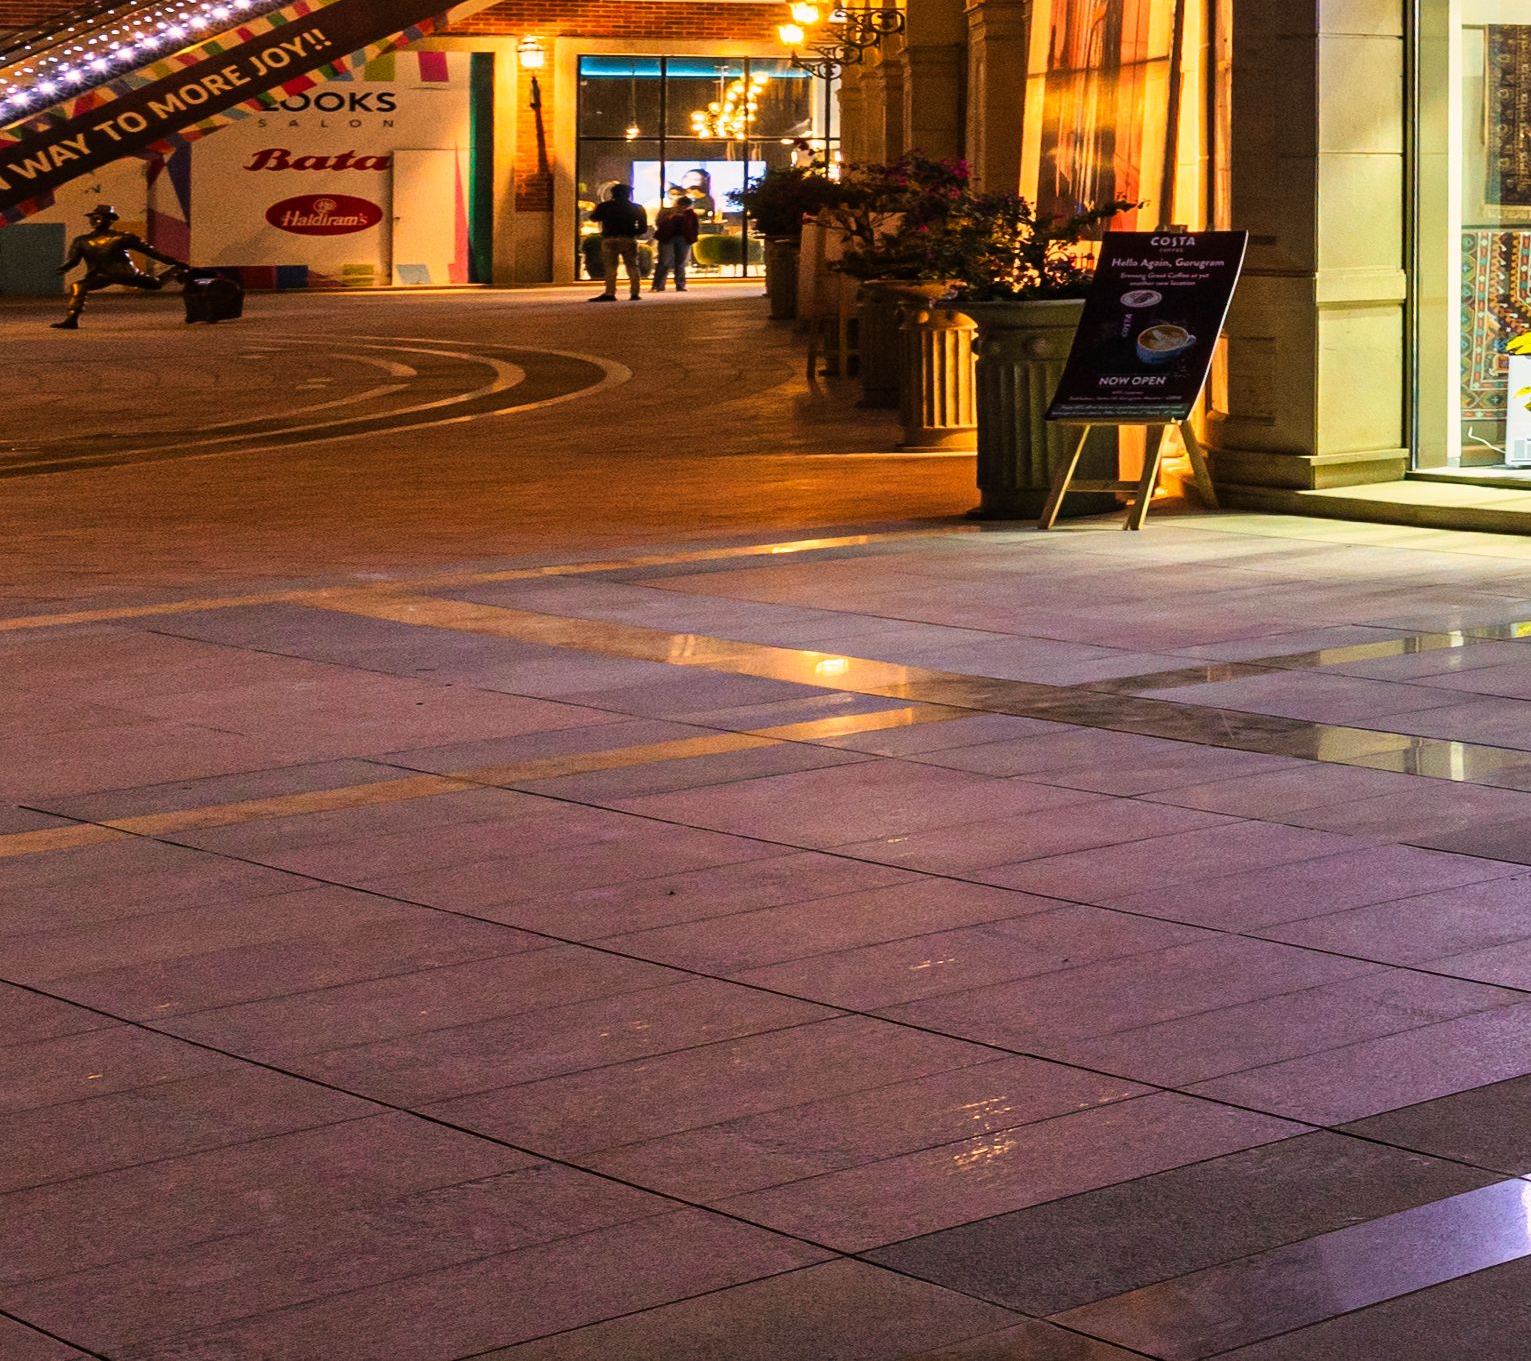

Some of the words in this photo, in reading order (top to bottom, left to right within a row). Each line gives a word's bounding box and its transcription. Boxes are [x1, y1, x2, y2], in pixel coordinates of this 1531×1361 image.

[9, 132, 93, 180] WAY
[93, 110, 149, 143] TO
[149, 63, 252, 121] MORE
[250, 27, 333, 77] JOY!!
[261, 91, 397, 113] OOKS
[257, 119, 395, 128] SALON
[243, 147, 394, 172] Bata
[281, 210, 369, 227] Haldiram's
[1150, 236, 1196, 247] COSTA
[1111, 258, 1139, 267] Hello
[1140, 258, 1173, 270] Again,
[1175, 257, 1225, 270] Gurugram
[1098, 376, 1131, 386] NOW
[1131, 376, 1167, 386] OPEN
